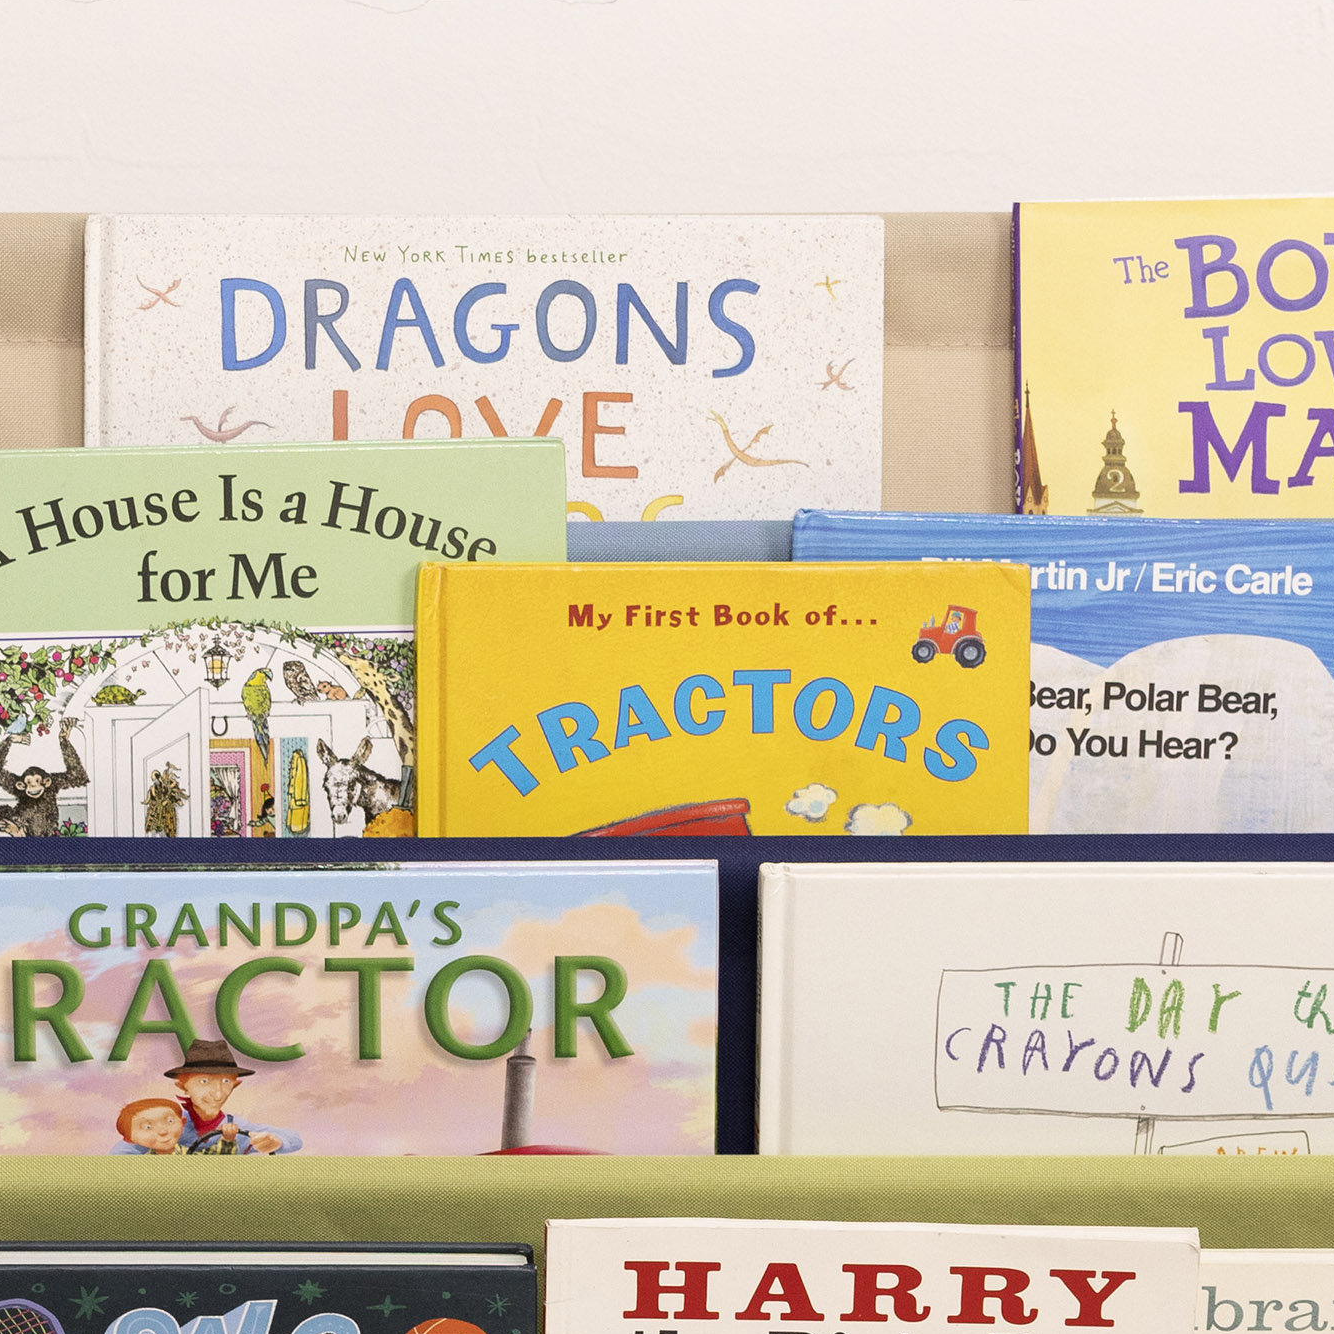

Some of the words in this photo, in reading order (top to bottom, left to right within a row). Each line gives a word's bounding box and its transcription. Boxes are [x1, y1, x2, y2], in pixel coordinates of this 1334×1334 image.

[527, 248, 628, 263] bestseller
[1113, 255, 1170, 285] The
[220, 277, 761, 378] DRAGONS
[1107, 469, 1126, 493] 2
[14, 487, 199, 555] House
[218, 474, 263, 522] Is
[279, 490, 308, 525] a
[321, 480, 497, 562] House
[137, 550, 216, 603] for
[226, 552, 320, 601] Me
[1096, 561, 1130, 591] Jr
[1152, 562, 1217, 593] Eric
[1225, 563, 1313, 596] Carle
[568, 604, 612, 630] My
[625, 605, 700, 627] First
[714, 603, 790, 626] Book
[804, 603, 879, 627] of...
[1030, 680, 1092, 715] ear,
[1103, 681, 1189, 713] Polar
[1197, 685, 1279, 720] Bear,
[468, 669, 991, 797] TRACTORS
[1029, 728, 1057, 756] o
[1065, 727, 1129, 758] You
[1138, 730, 1239, 761] Hear?
[67, 900, 463, 949] GRANDPA'S
[994, 981, 1083, 1020] THE
[1127, 976, 1243, 1040] DAY
[945, 1023, 1205, 1094] CRAYONS
[622, 1260, 1137, 1327] HARRY
